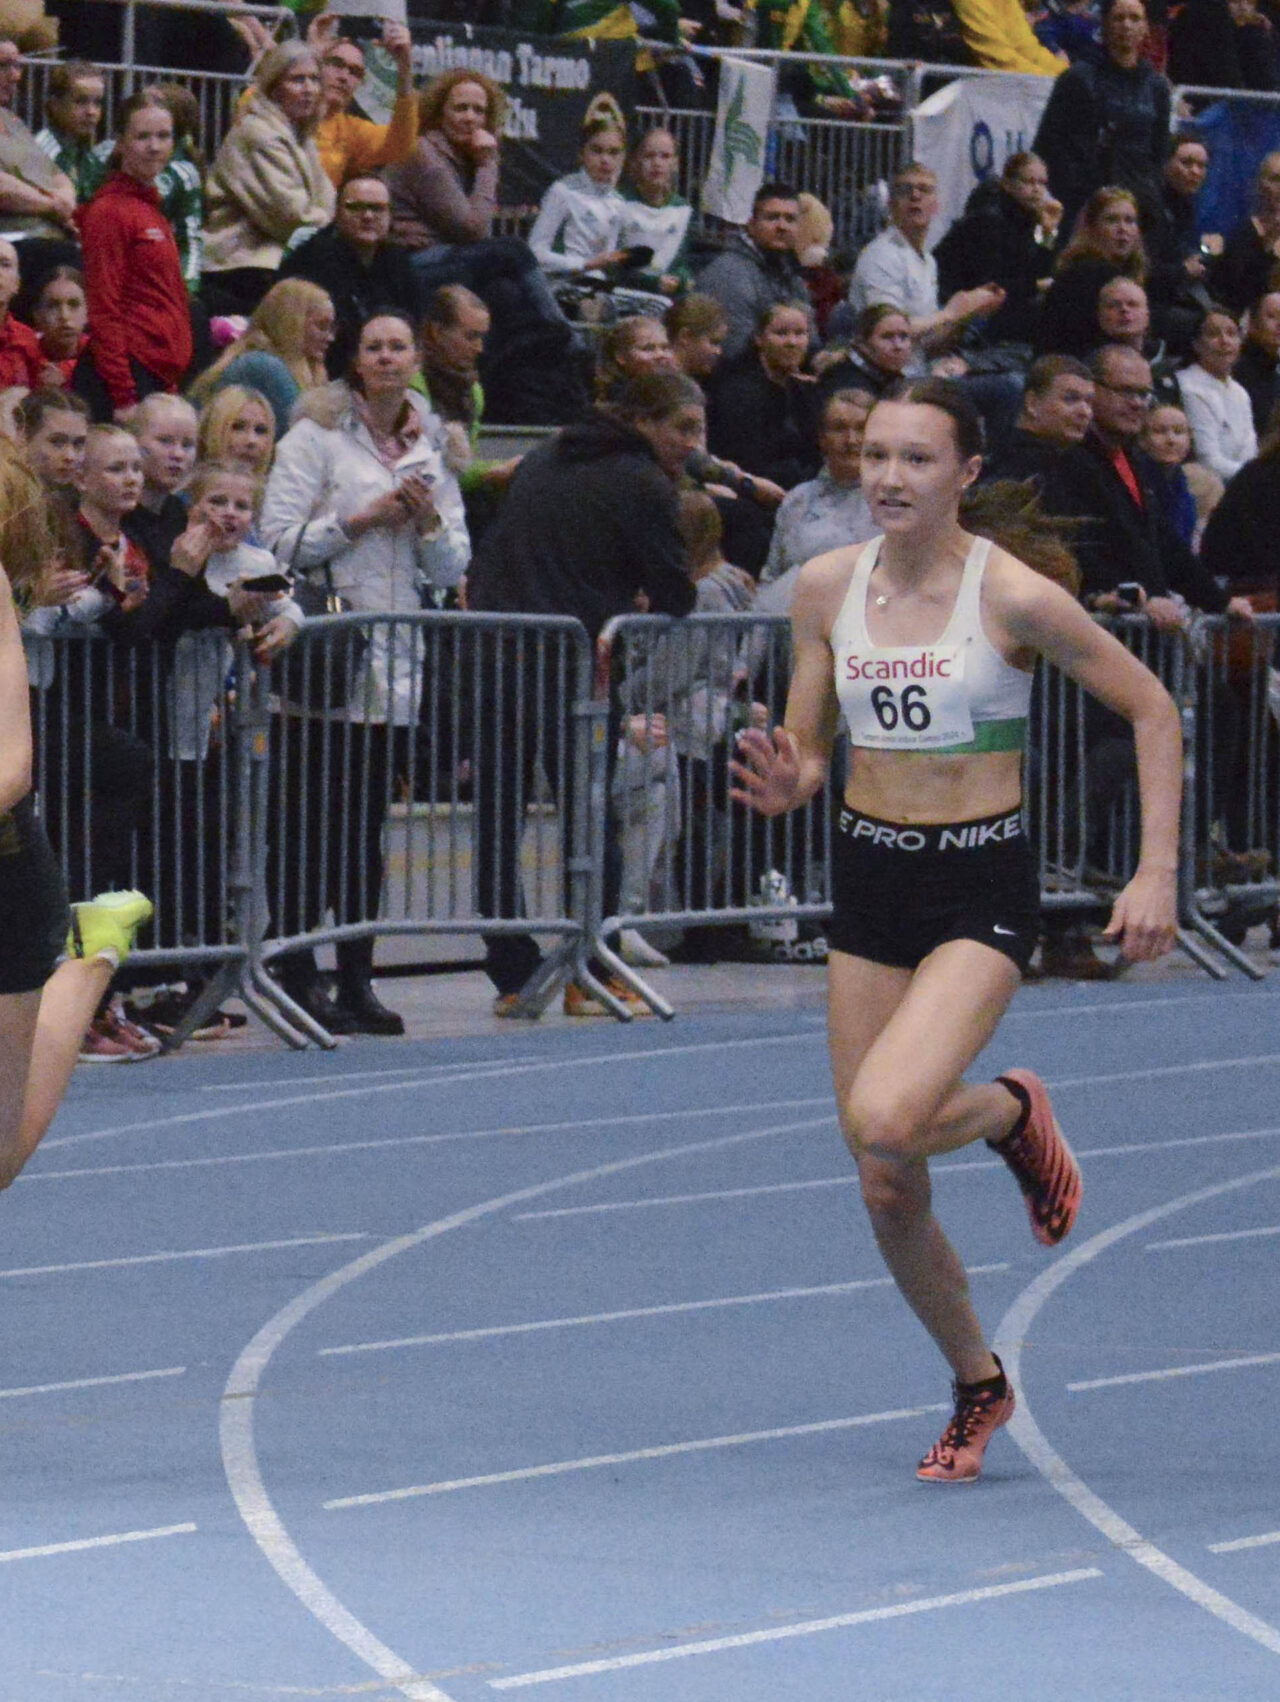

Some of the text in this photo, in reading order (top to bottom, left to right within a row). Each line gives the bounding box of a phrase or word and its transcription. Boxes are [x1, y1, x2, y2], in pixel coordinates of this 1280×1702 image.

[846, 652, 951, 681] Scandic
[871, 684, 931, 732] 66
[852, 819, 926, 851] PRO
[938, 813, 1021, 851] NIKE
